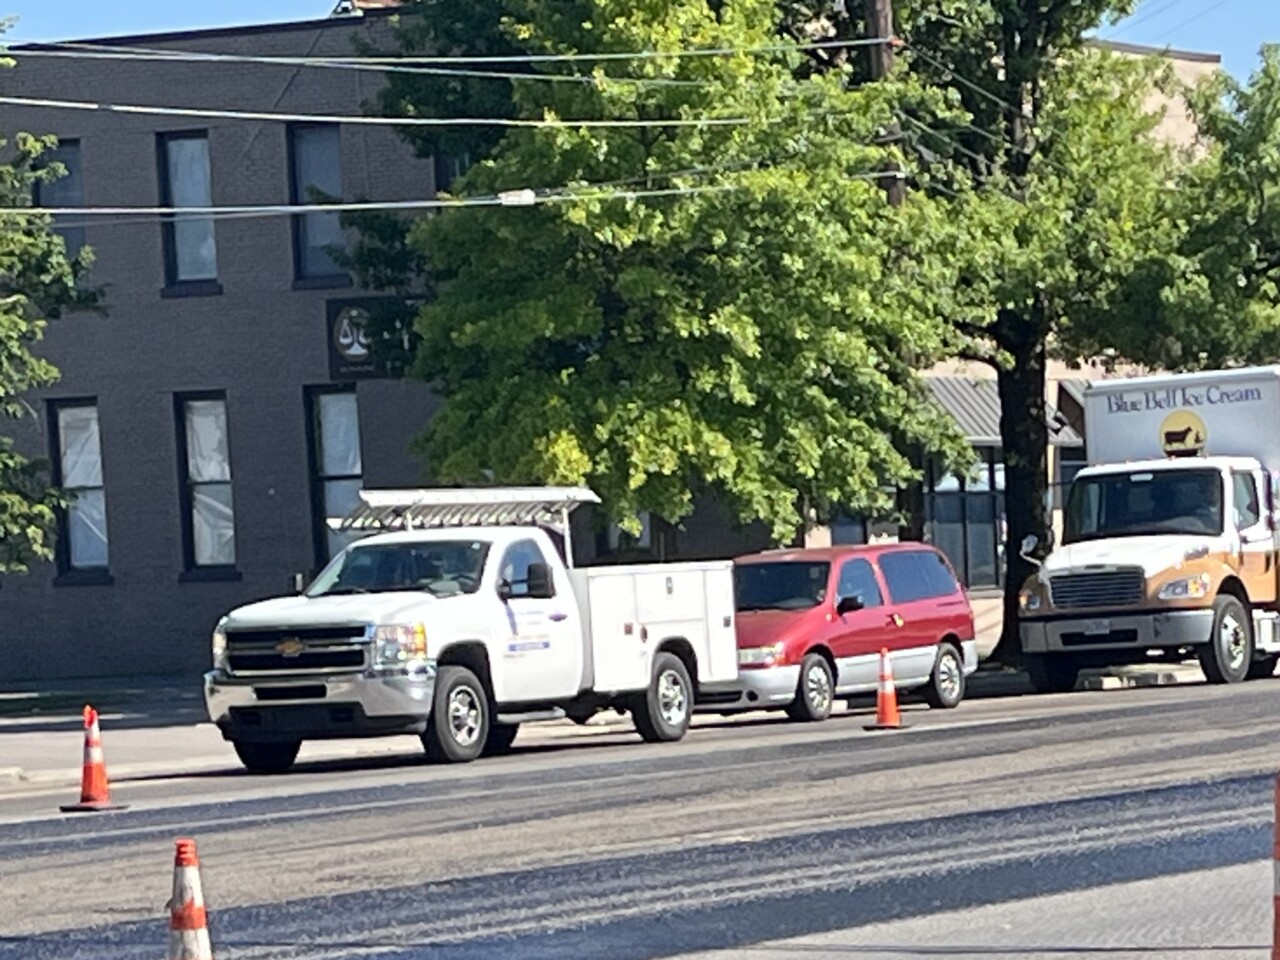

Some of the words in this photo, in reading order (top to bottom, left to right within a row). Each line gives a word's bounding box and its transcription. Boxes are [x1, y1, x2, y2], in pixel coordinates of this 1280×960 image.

[1107, 393, 1141, 414] Blue
[1144, 388, 1177, 410] Bell
[1181, 386, 1204, 408] Ice
[1206, 384, 1262, 405] Cream
